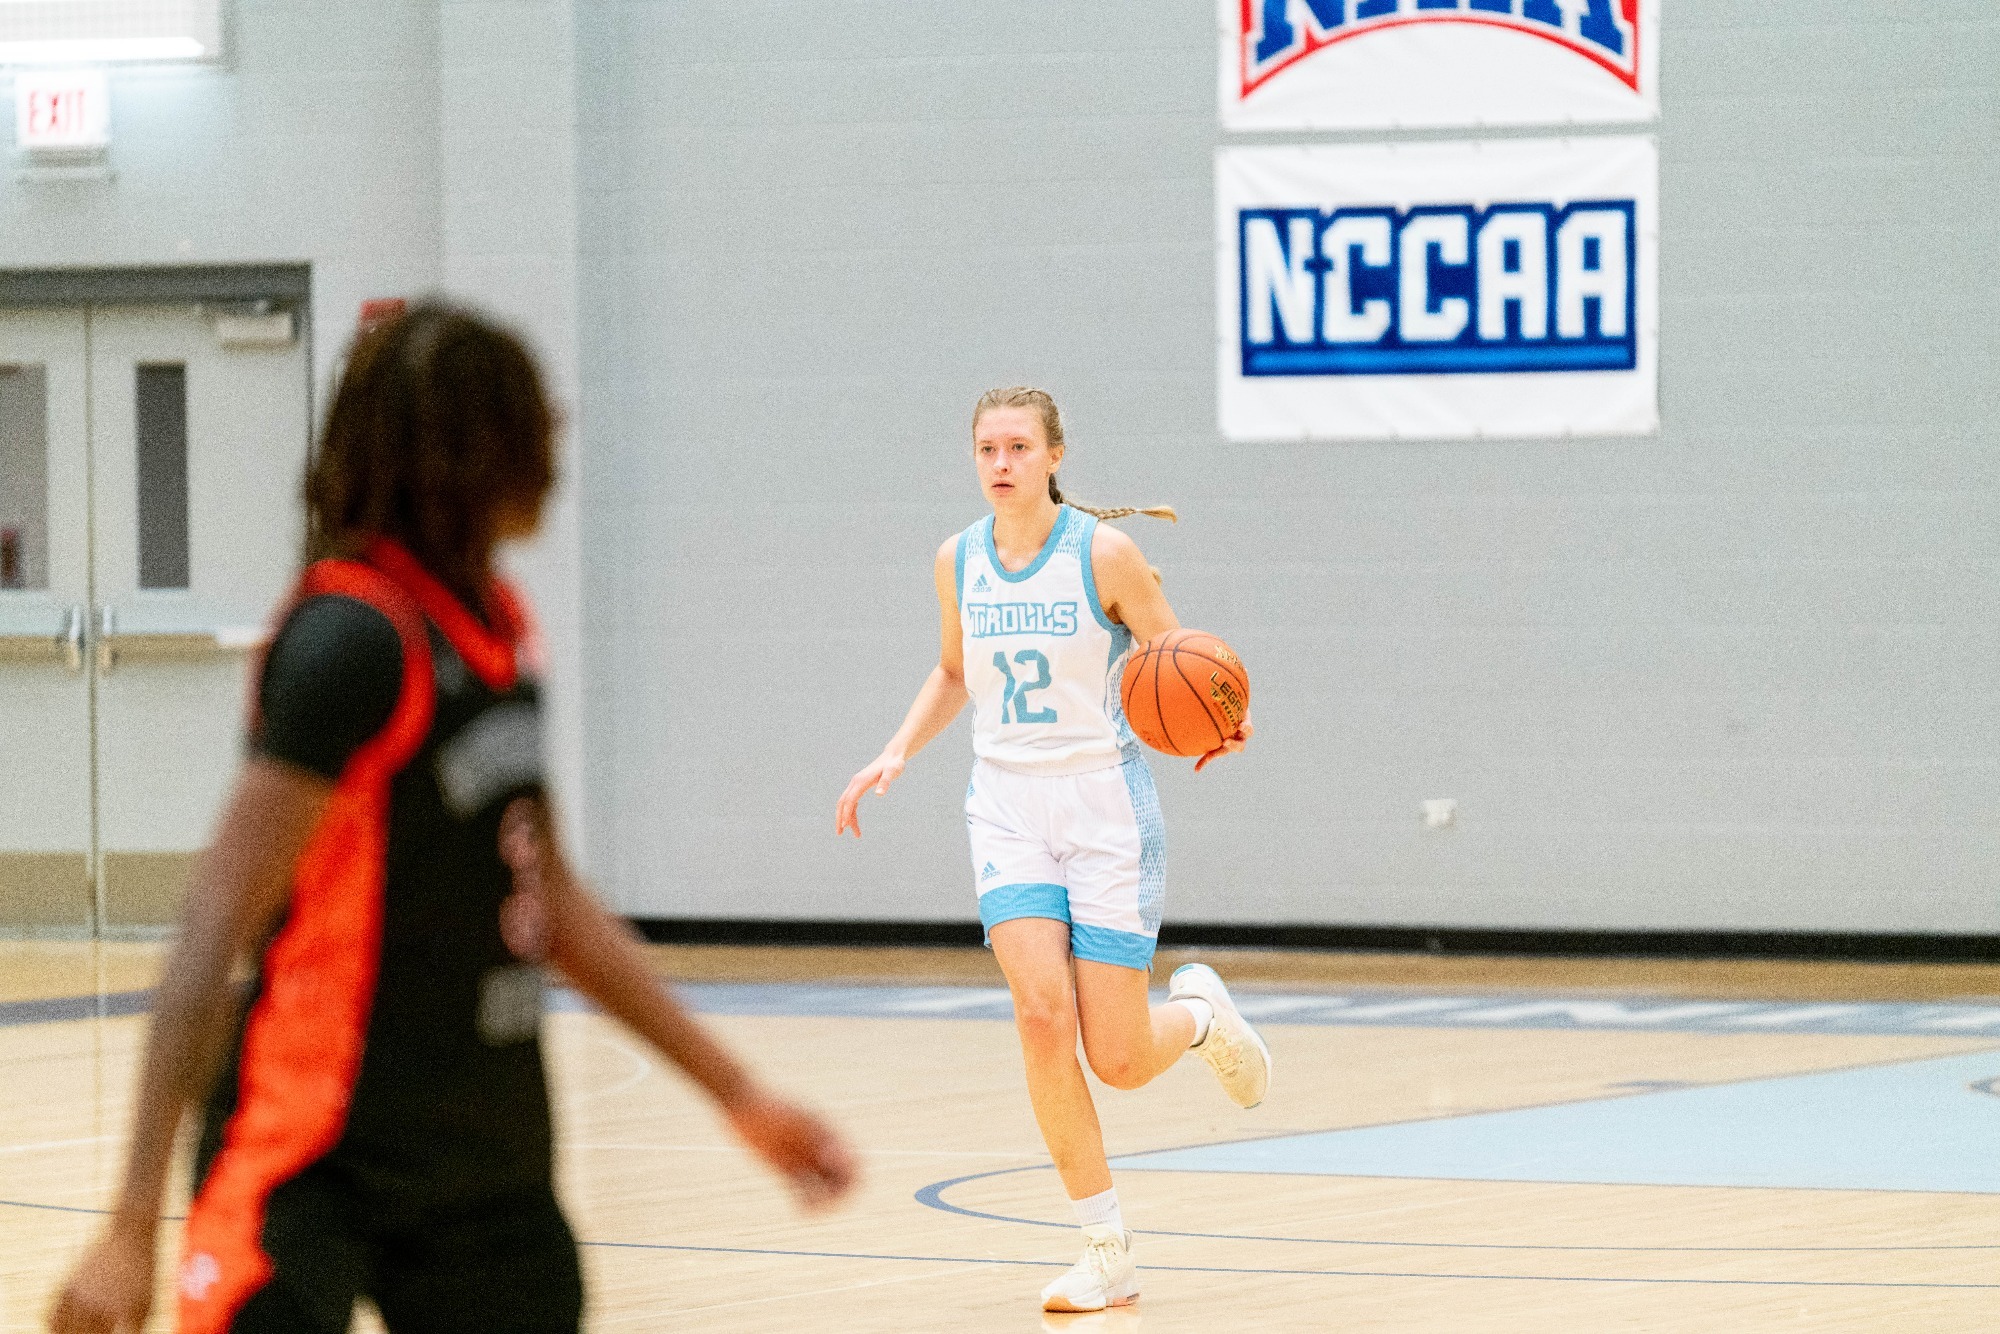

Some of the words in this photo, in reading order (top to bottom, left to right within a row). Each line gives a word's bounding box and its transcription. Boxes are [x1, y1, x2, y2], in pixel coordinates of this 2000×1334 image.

[27, 90, 85, 136] EXIT
[1244, 209, 1628, 345] NCCAA
[967, 601, 1078, 638] TROLLS
[992, 649, 1058, 724] 12
